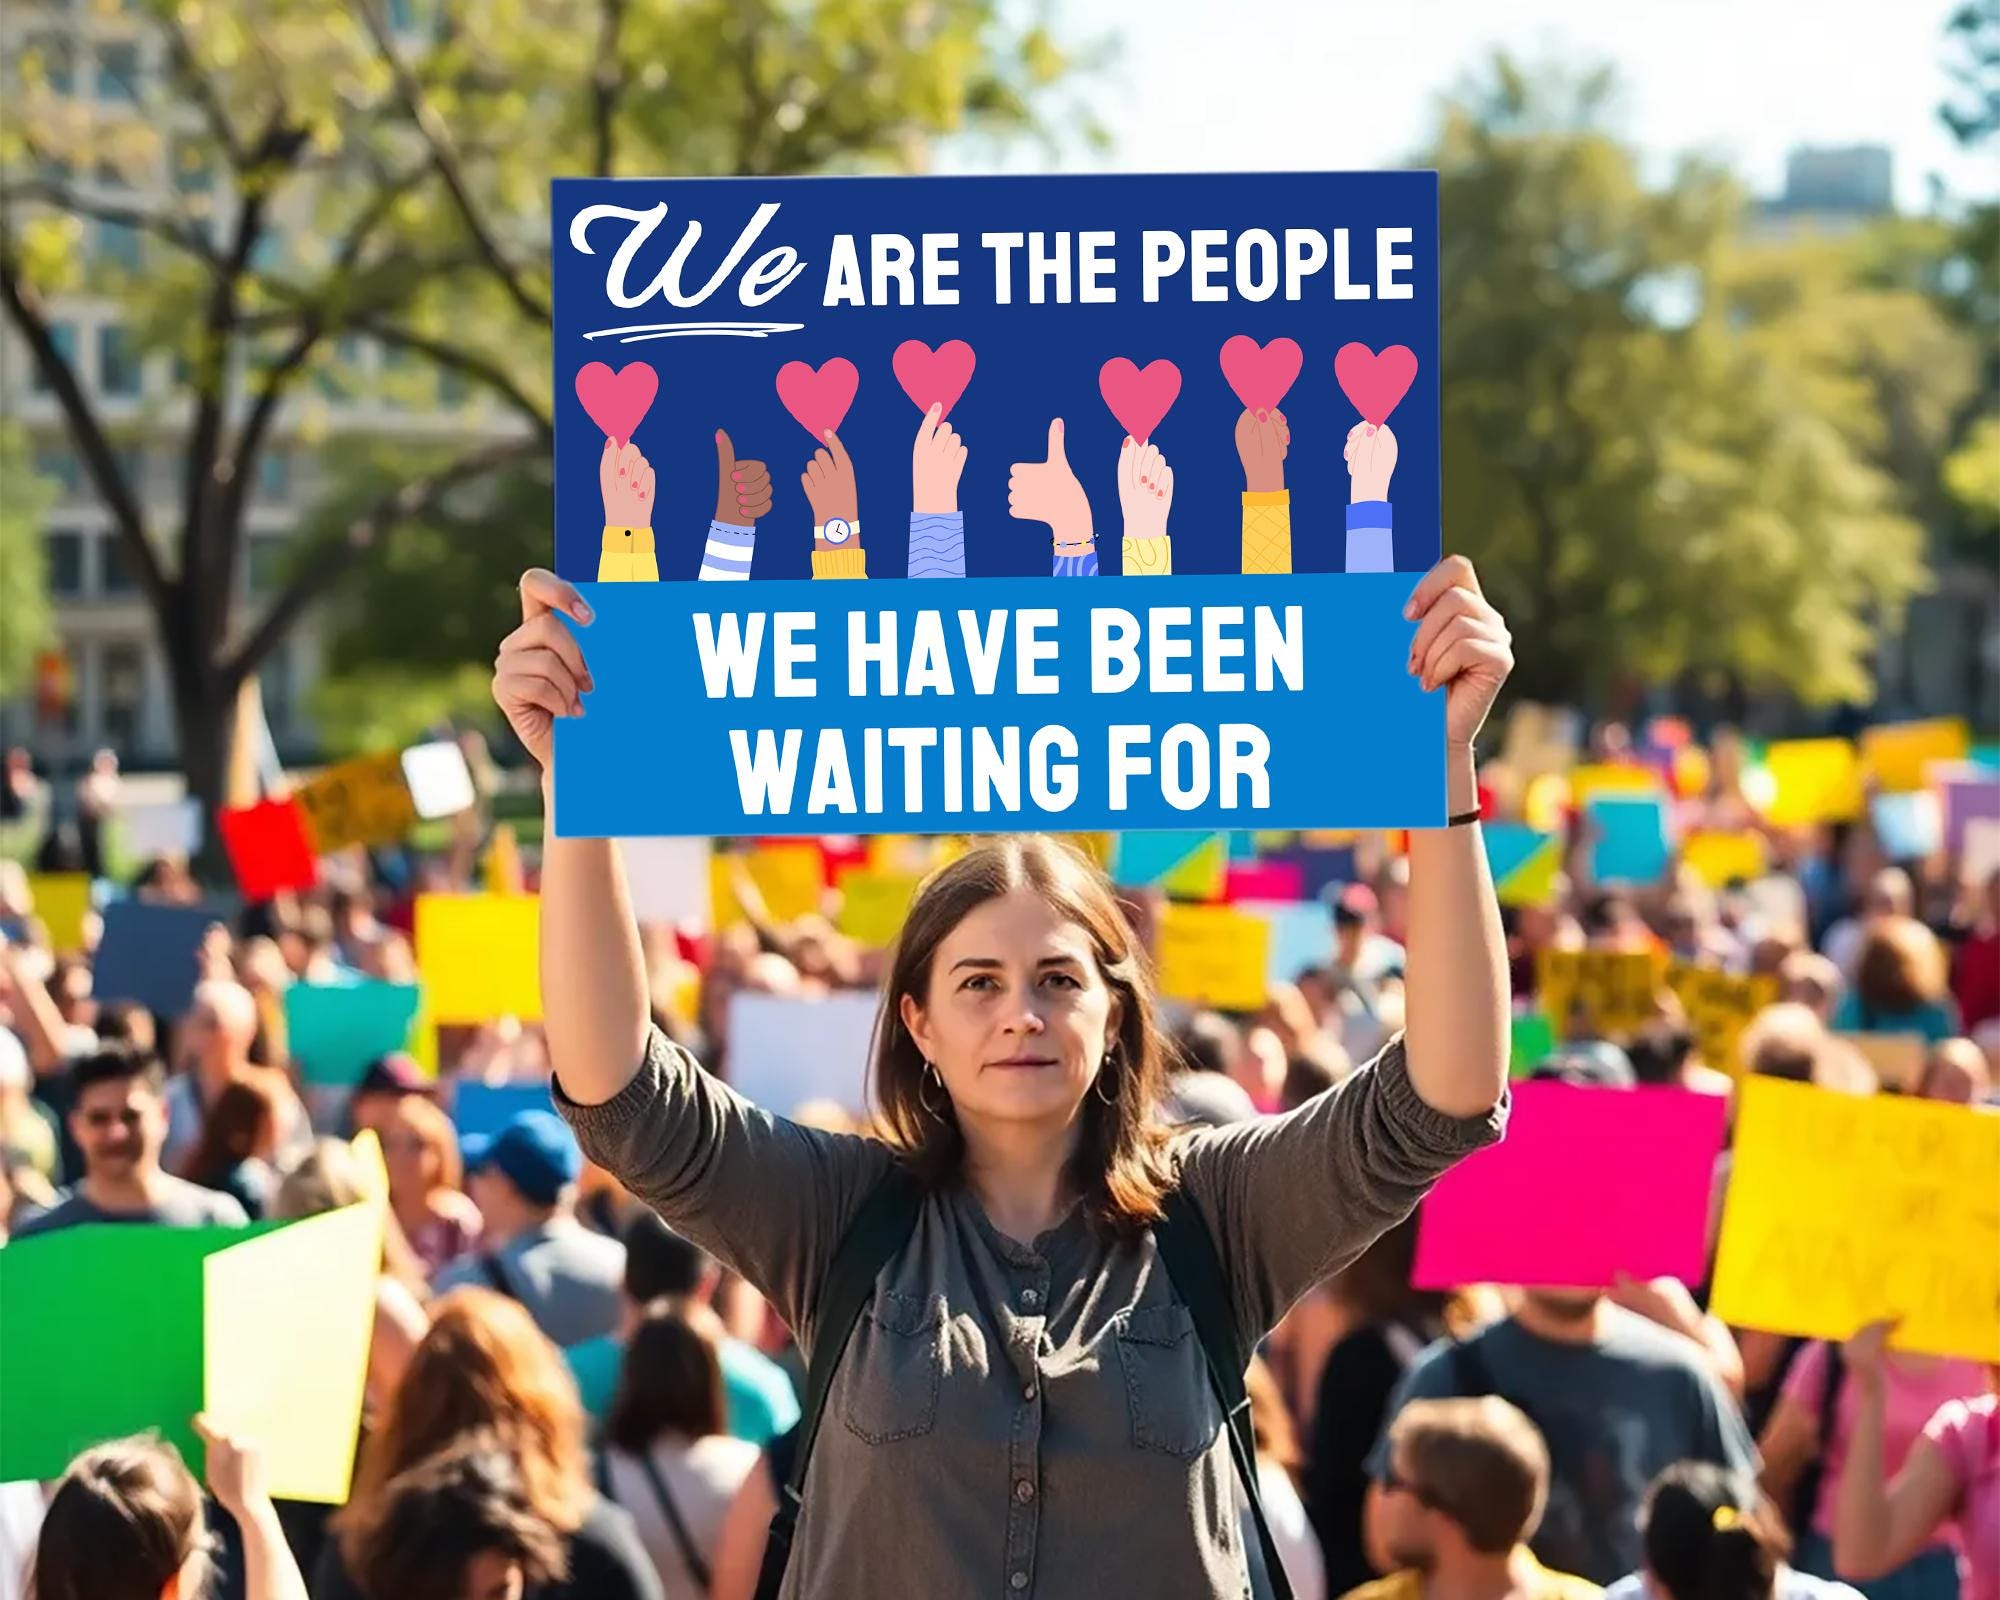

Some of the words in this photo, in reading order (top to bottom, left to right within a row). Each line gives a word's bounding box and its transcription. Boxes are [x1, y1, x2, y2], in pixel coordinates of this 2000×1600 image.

[570, 201, 807, 308] We
[823, 232, 959, 307] ARE
[982, 231, 1117, 305] THE
[1143, 227, 1414, 303] PEOPLE
[693, 611, 816, 698] WE
[848, 607, 1059, 697] HAVE
[1090, 605, 1304, 694] BEEN
[729, 726, 1079, 815] WAITING
[1108, 723, 1271, 811] FOR
